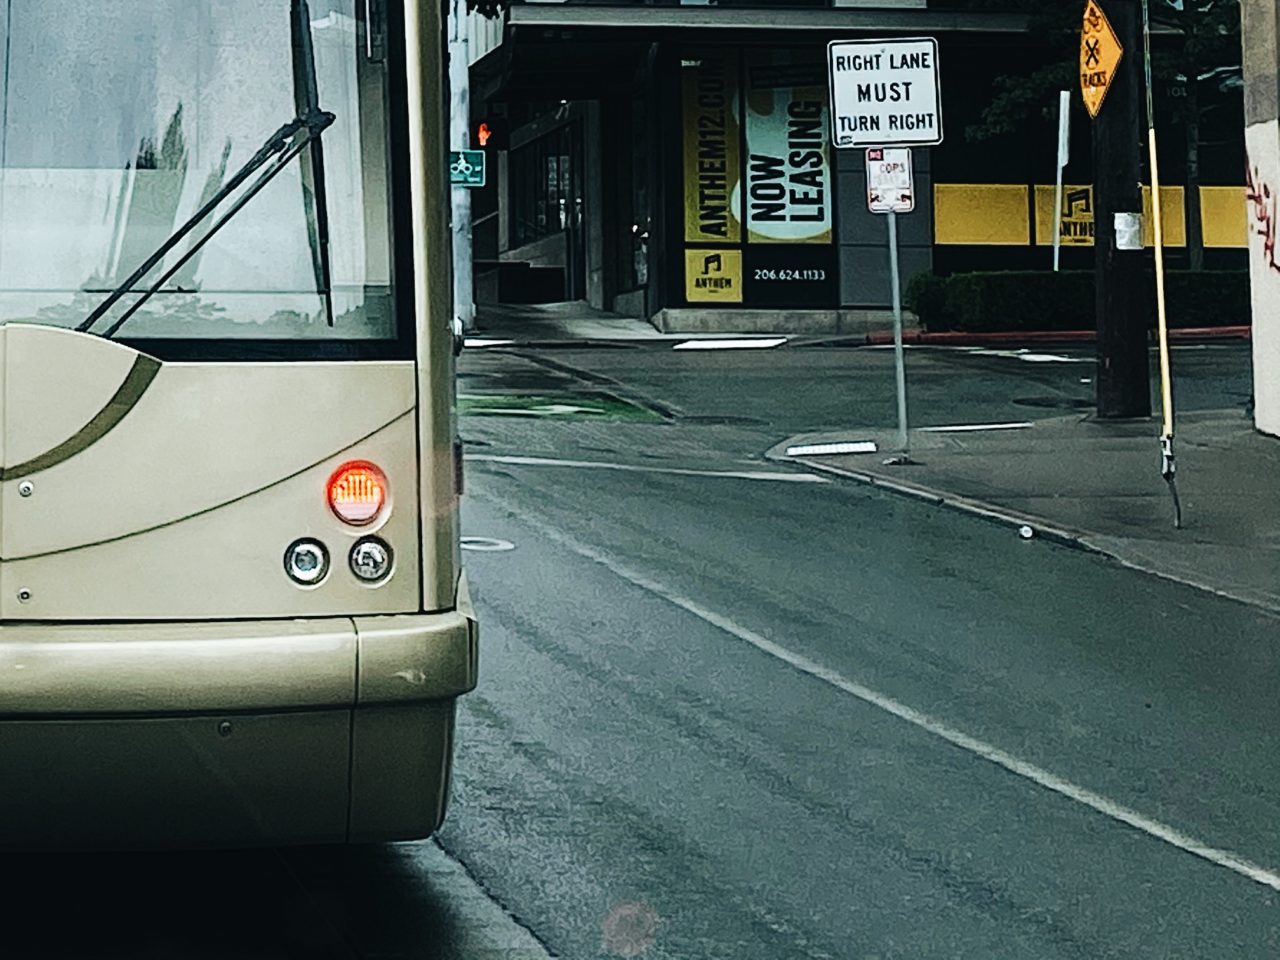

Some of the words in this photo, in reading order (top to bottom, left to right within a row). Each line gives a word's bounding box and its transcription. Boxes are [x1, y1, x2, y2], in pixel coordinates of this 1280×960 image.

[835, 53, 882, 72] RIGHT
[889, 52, 931, 70] LANE
[856, 81, 913, 102] MUST
[838, 115, 880, 133] TURN
[887, 113, 935, 131] RIGHT
[698, 58, 728, 238] ANTHEM12.COM
[787, 100, 825, 222] LEASING
[750, 154, 787, 222] NOW
[694, 277, 732, 290] ANTHEM
[754, 269, 826, 281] 206.624.1133
